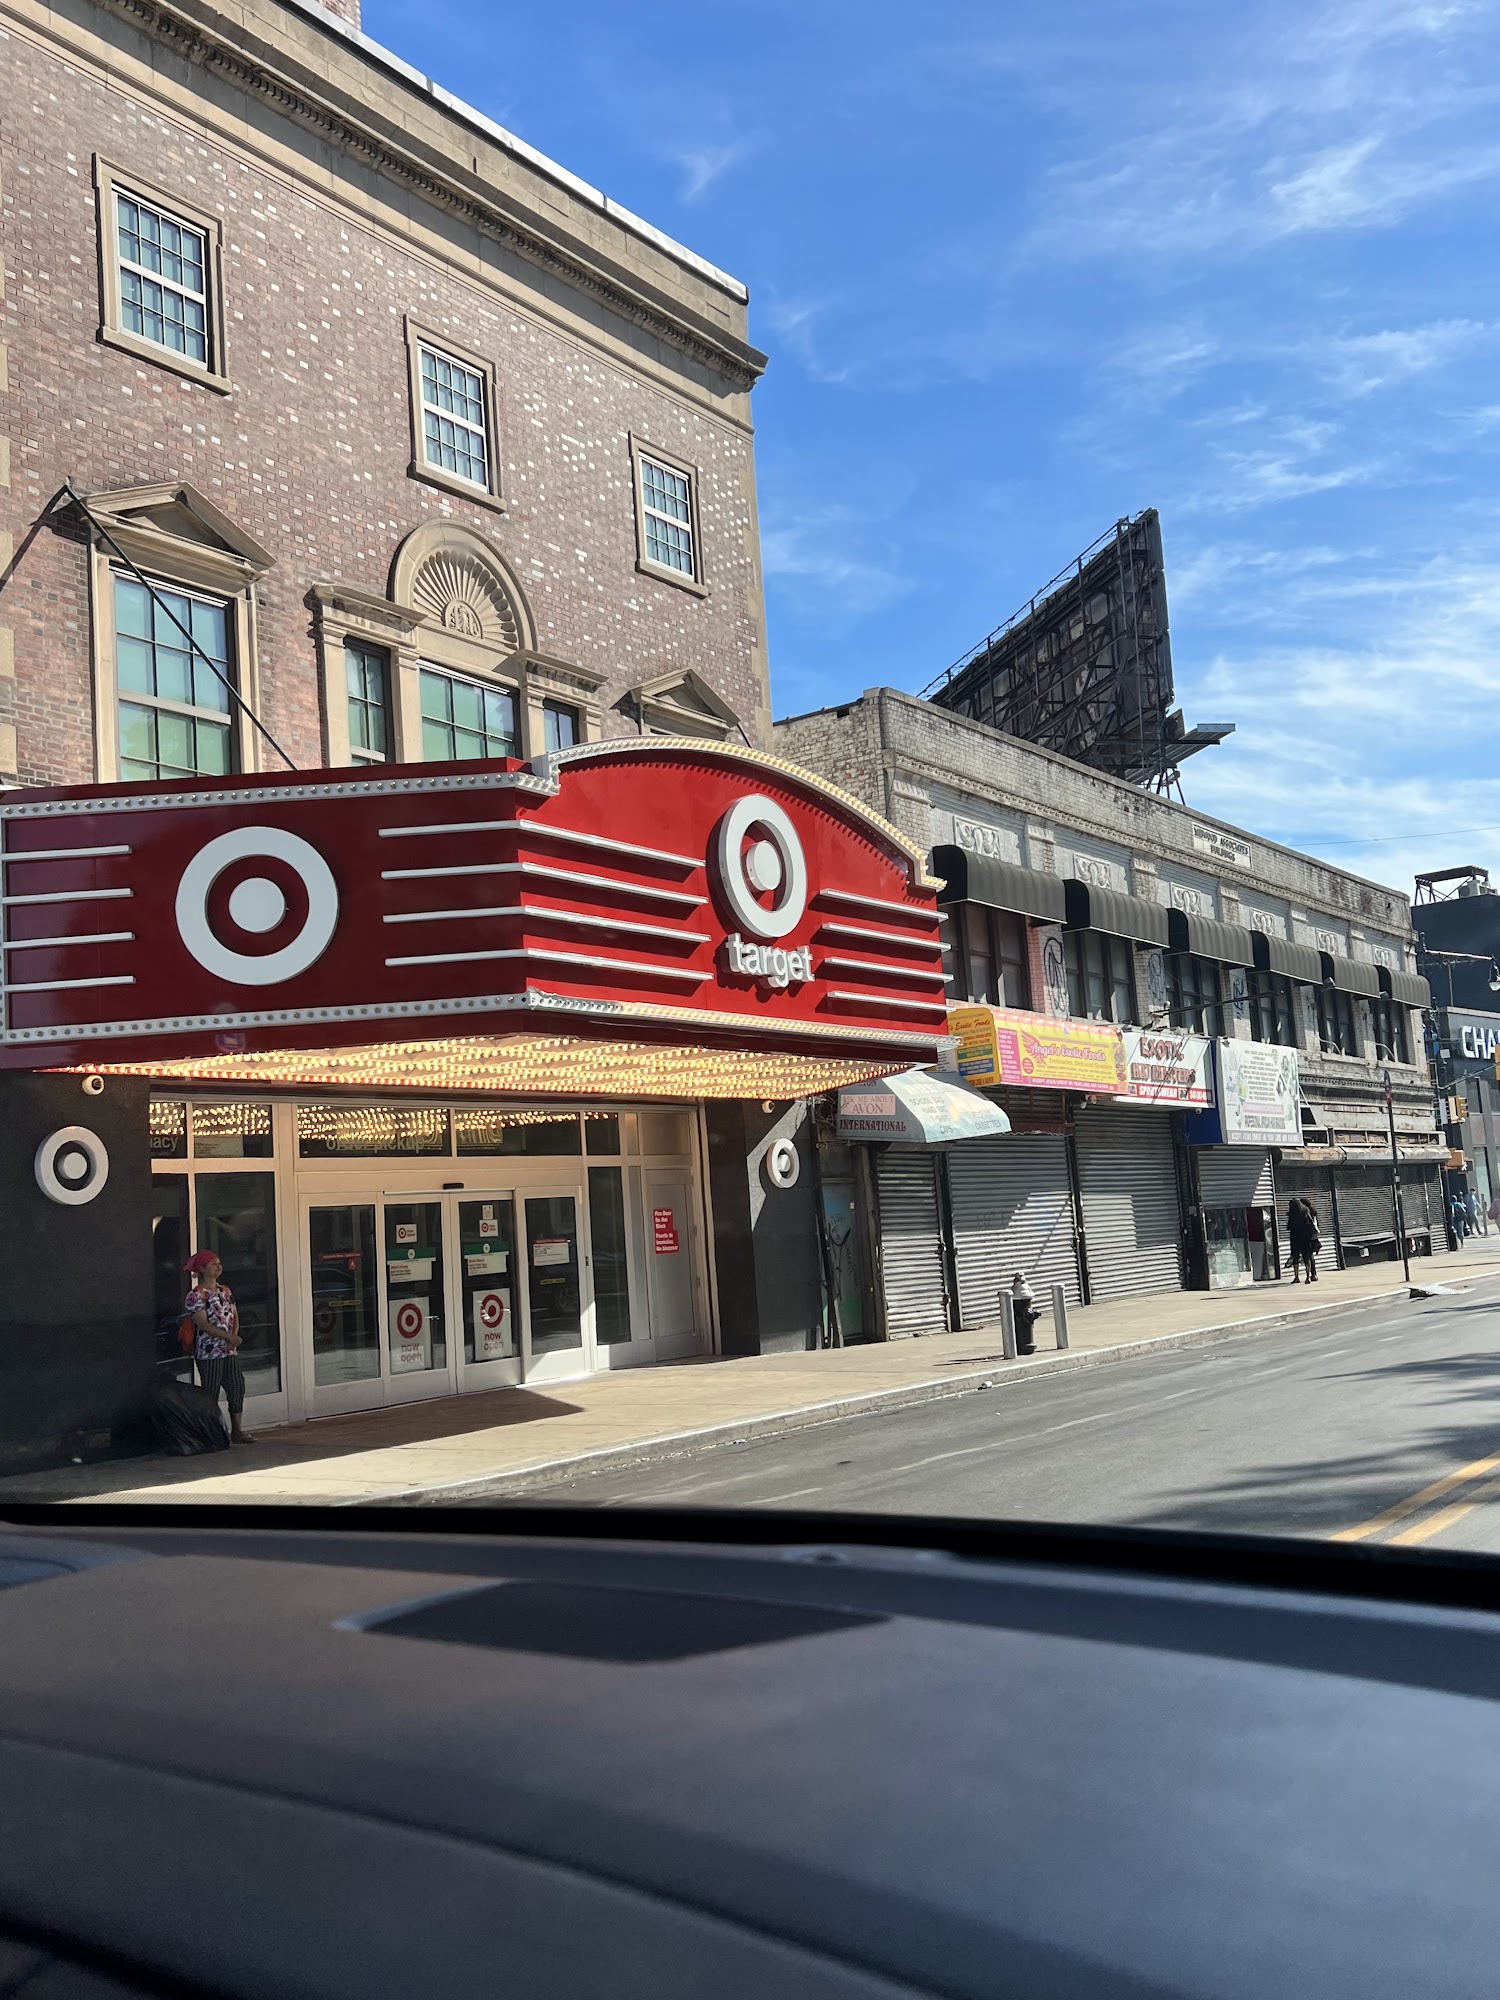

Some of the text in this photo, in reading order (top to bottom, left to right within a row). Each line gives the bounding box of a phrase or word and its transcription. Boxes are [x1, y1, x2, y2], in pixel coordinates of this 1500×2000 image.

[726, 932, 816, 988] target
[1460, 1025, 1500, 1060] CHA
[1031, 1042, 1061, 1058] Angel's
[1061, 1045, 1083, 1059] Exotic
[1083, 1048, 1106, 1062] Foods
[870, 1095, 894, 1103] ABOUT
[852, 1103, 884, 1115] AVON
[840, 1119, 906, 1132] INTERNATIONAL
[939, 1125, 953, 1135] CAPS
[974, 1120, 1001, 1131] CASSETTES
[150, 1136, 179, 1152] acy
[373, 1132, 425, 1154] pickup
[484, 1331, 501, 1341] now
[401, 1343, 420, 1353] now
[484, 1340, 504, 1351] open
[401, 1352, 422, 1363] open
